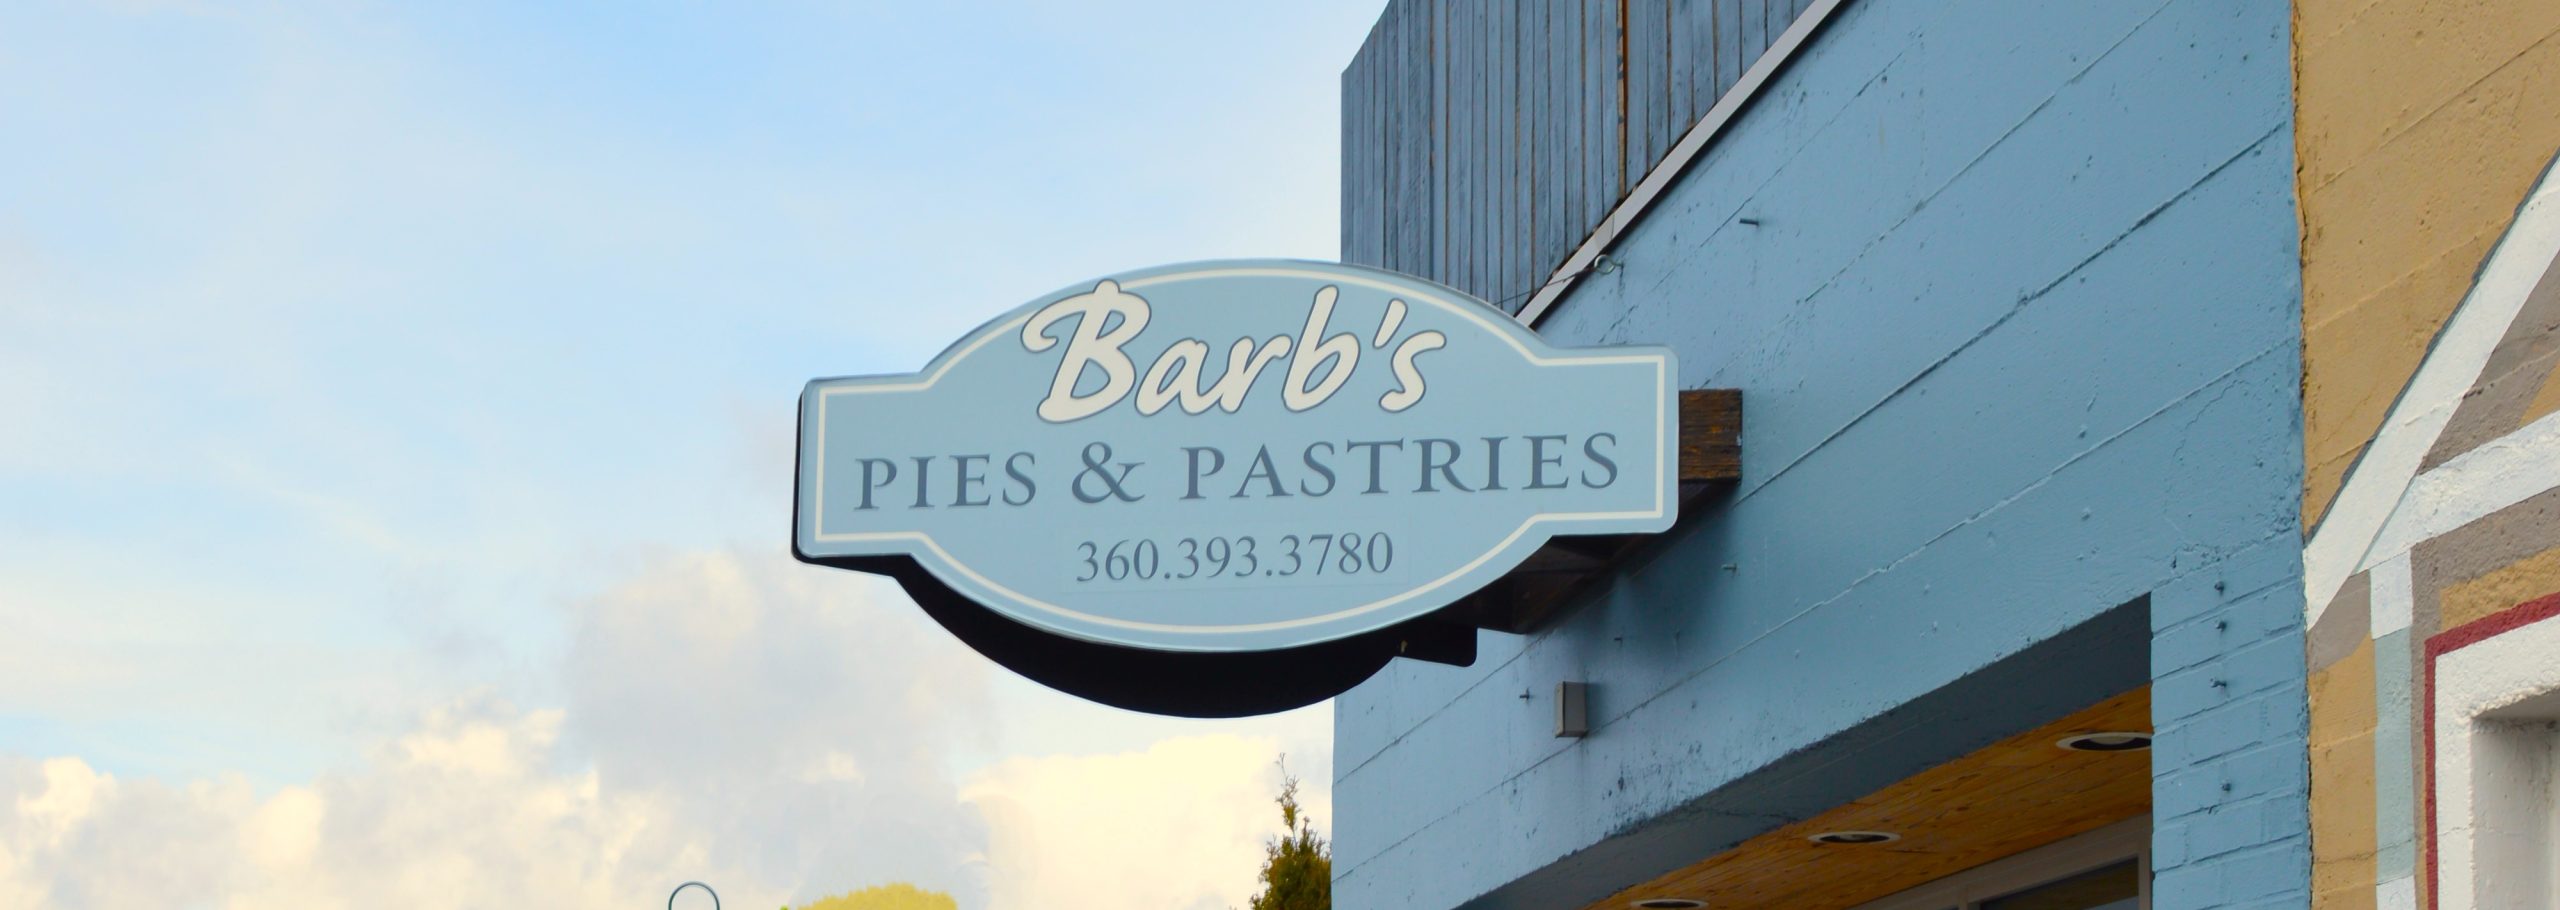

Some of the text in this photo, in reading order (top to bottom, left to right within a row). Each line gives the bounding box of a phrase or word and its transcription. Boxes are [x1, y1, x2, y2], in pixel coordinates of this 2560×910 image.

[1020, 279, 1447, 424] Barb's
[854, 431, 1621, 510] PIES & PASTRIES
[1076, 532, 1394, 583] 360.393.3780
